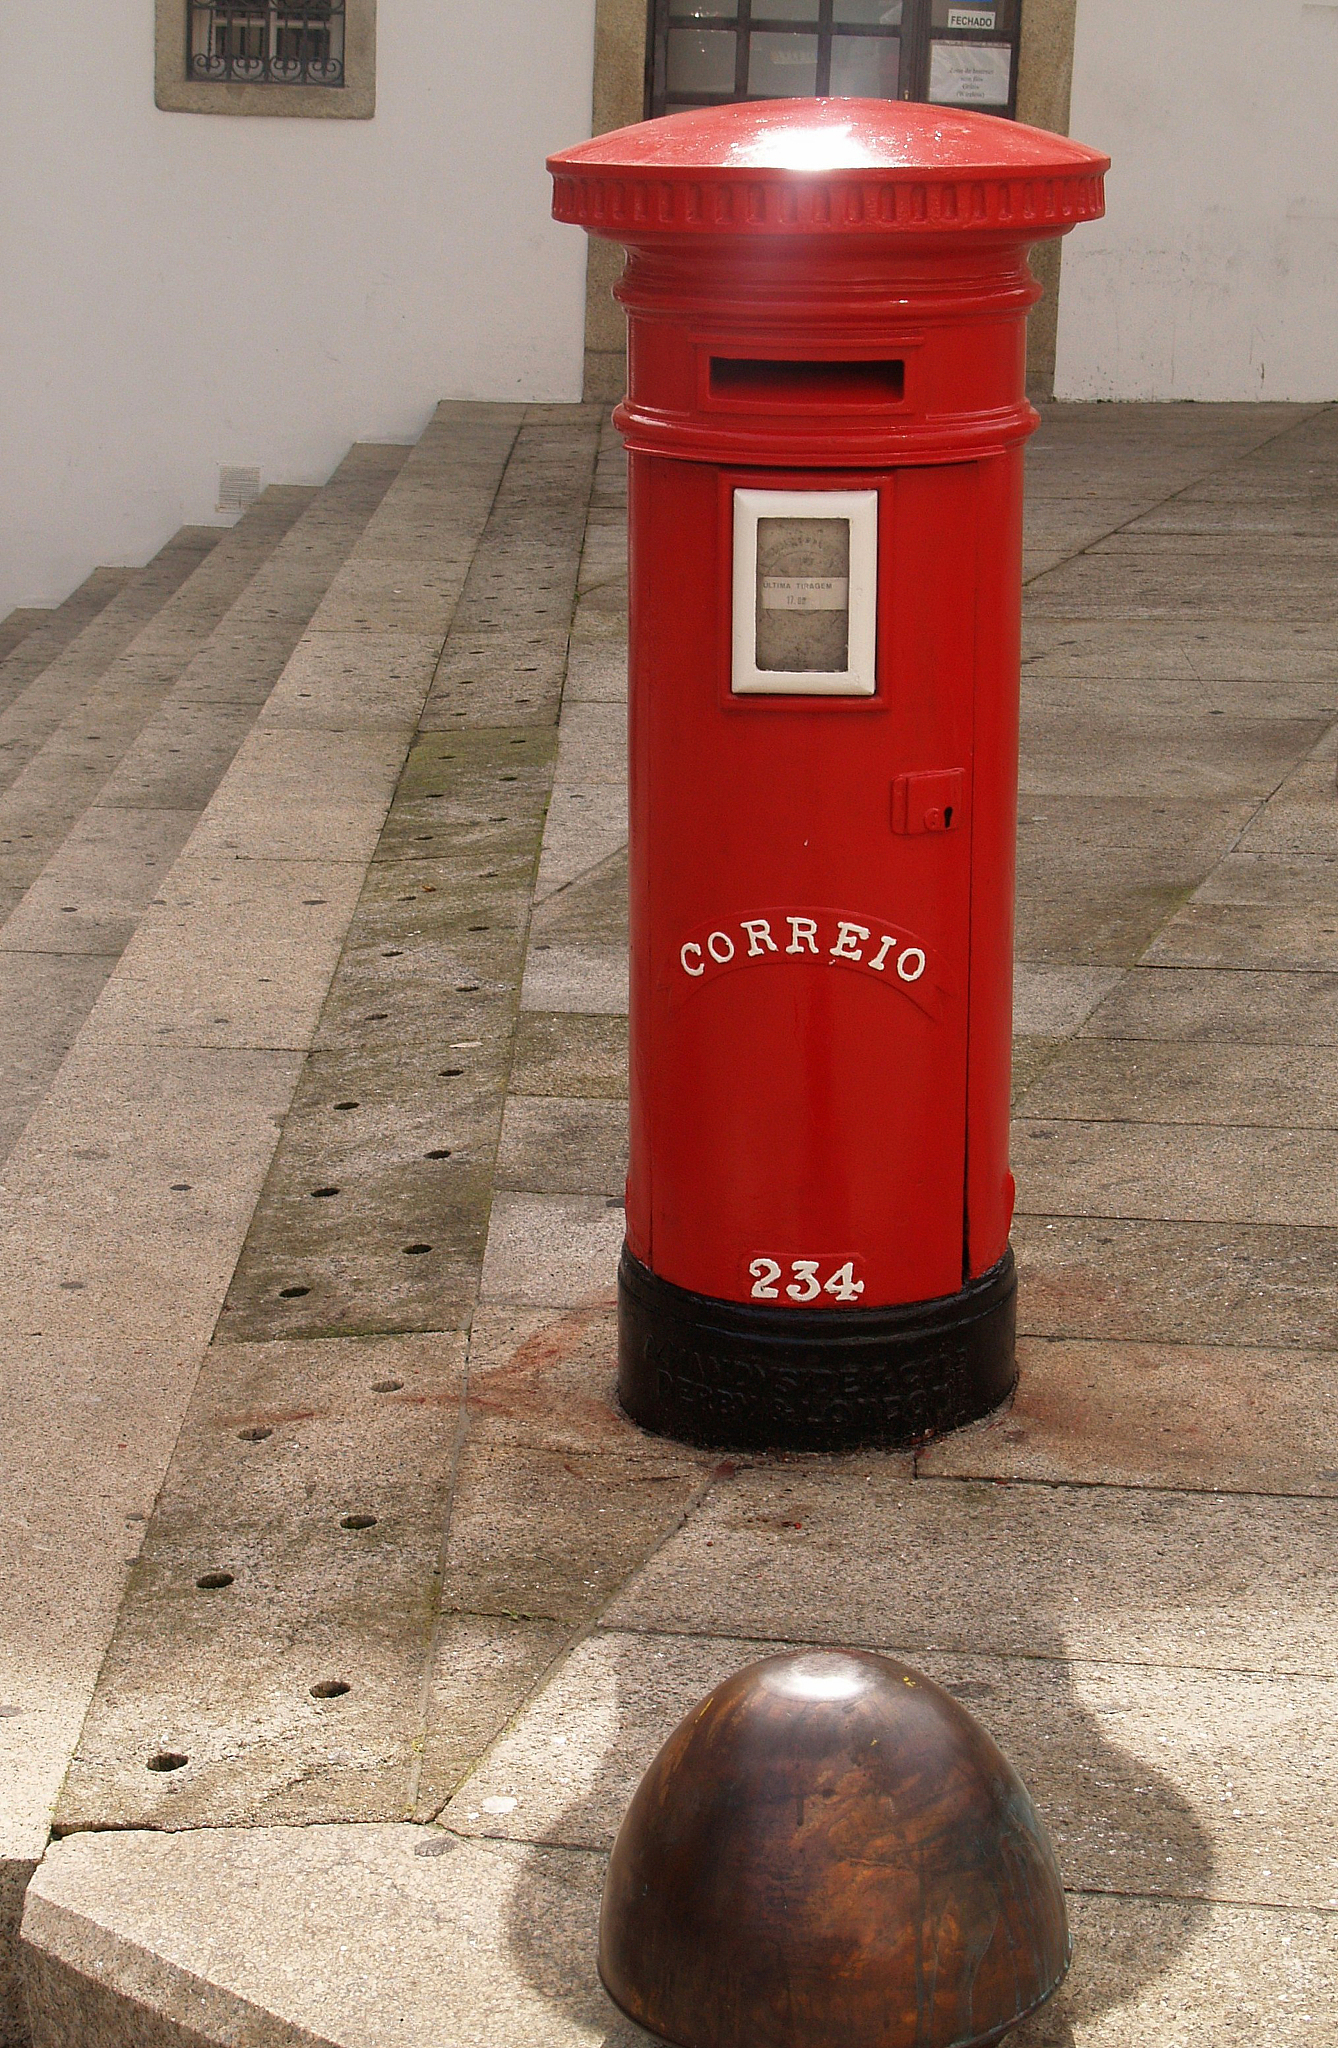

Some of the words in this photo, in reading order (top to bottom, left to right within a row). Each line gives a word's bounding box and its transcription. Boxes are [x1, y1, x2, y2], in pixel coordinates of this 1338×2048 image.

[950, 15, 992, 27] FECHADO
[796, 582, 833, 590] TIRAGEM
[680, 916, 926, 982] CORREIO
[749, 1258, 865, 1301] 234
